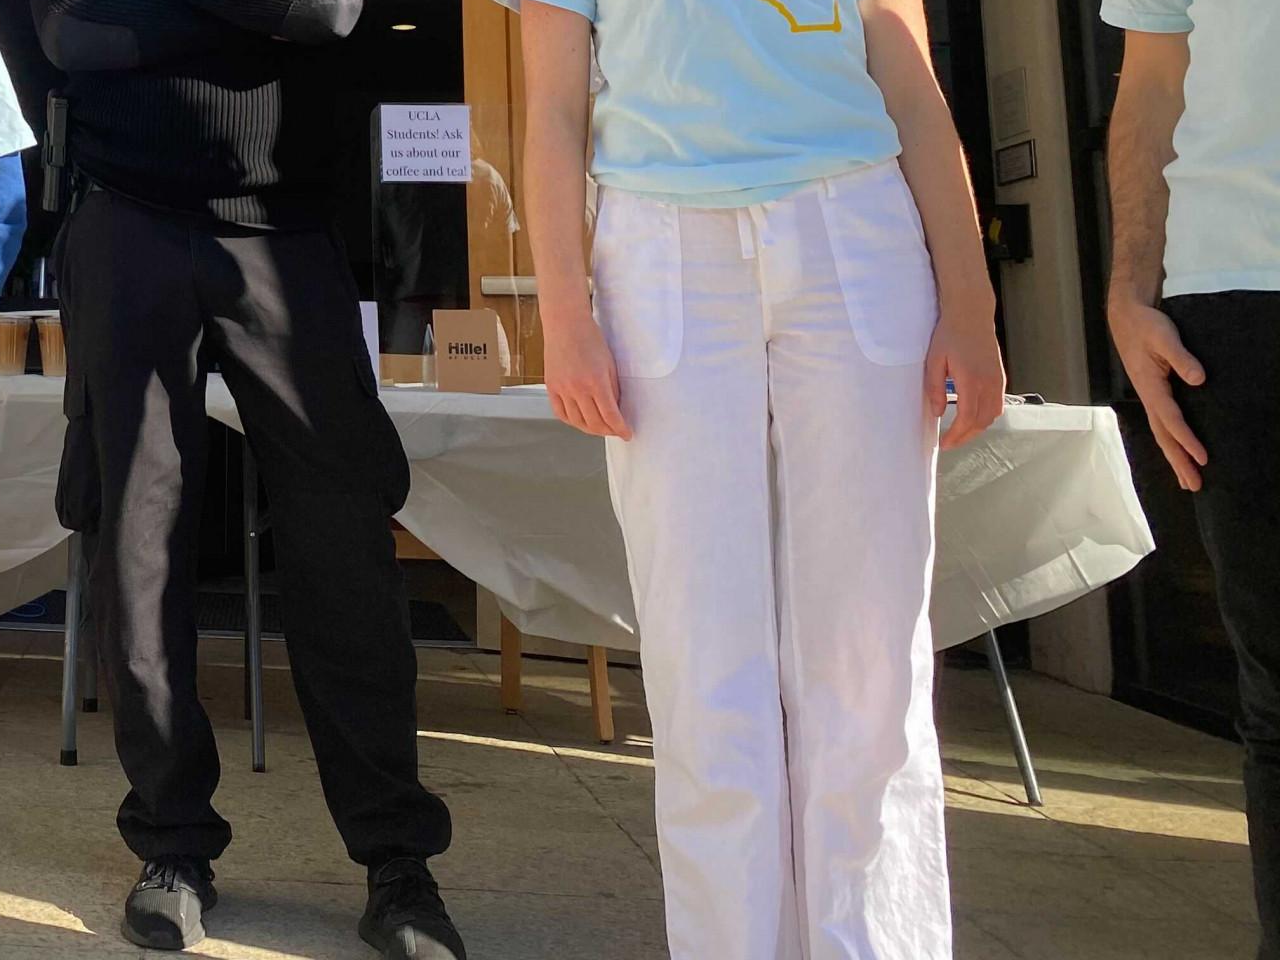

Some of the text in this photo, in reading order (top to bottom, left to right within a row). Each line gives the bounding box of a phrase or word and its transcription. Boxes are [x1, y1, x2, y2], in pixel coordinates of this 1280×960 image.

[408, 110, 441, 121] UCLA
[386, 128, 463, 140] Students! Ask
[390, 147, 461, 159] us about our
[386, 165, 467, 177] coffee and tea!
[448, 342, 487, 355] Hillel
